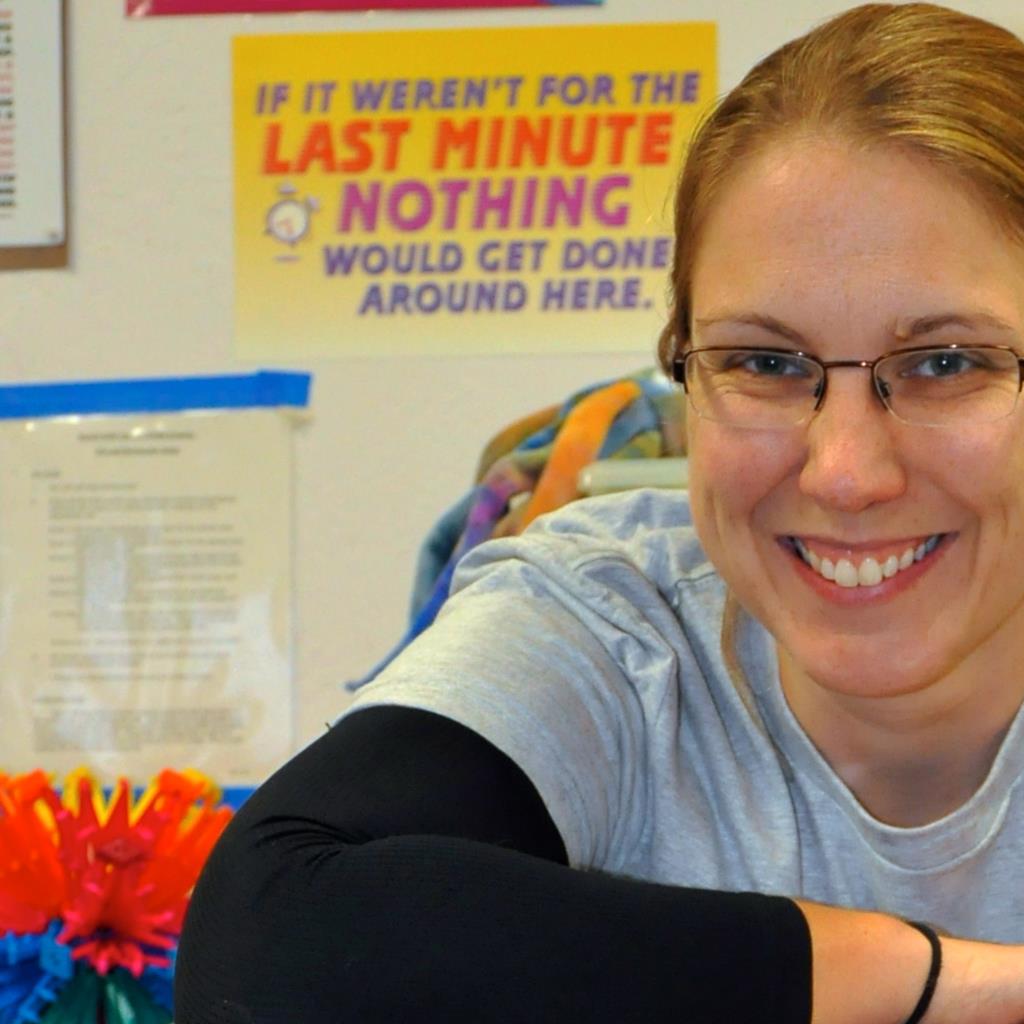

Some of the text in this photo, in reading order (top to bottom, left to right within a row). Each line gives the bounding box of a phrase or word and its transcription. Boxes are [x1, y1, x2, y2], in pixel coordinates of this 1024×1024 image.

[256, 72, 700, 115] IF IT WEREN'T FOR THE
[261, 112, 673, 175] LAST MINUTE
[337, 173, 631, 234] NOTHING
[323, 238, 671, 277] WOULD GET DONE
[358, 277, 653, 315] AROUND HERE.
